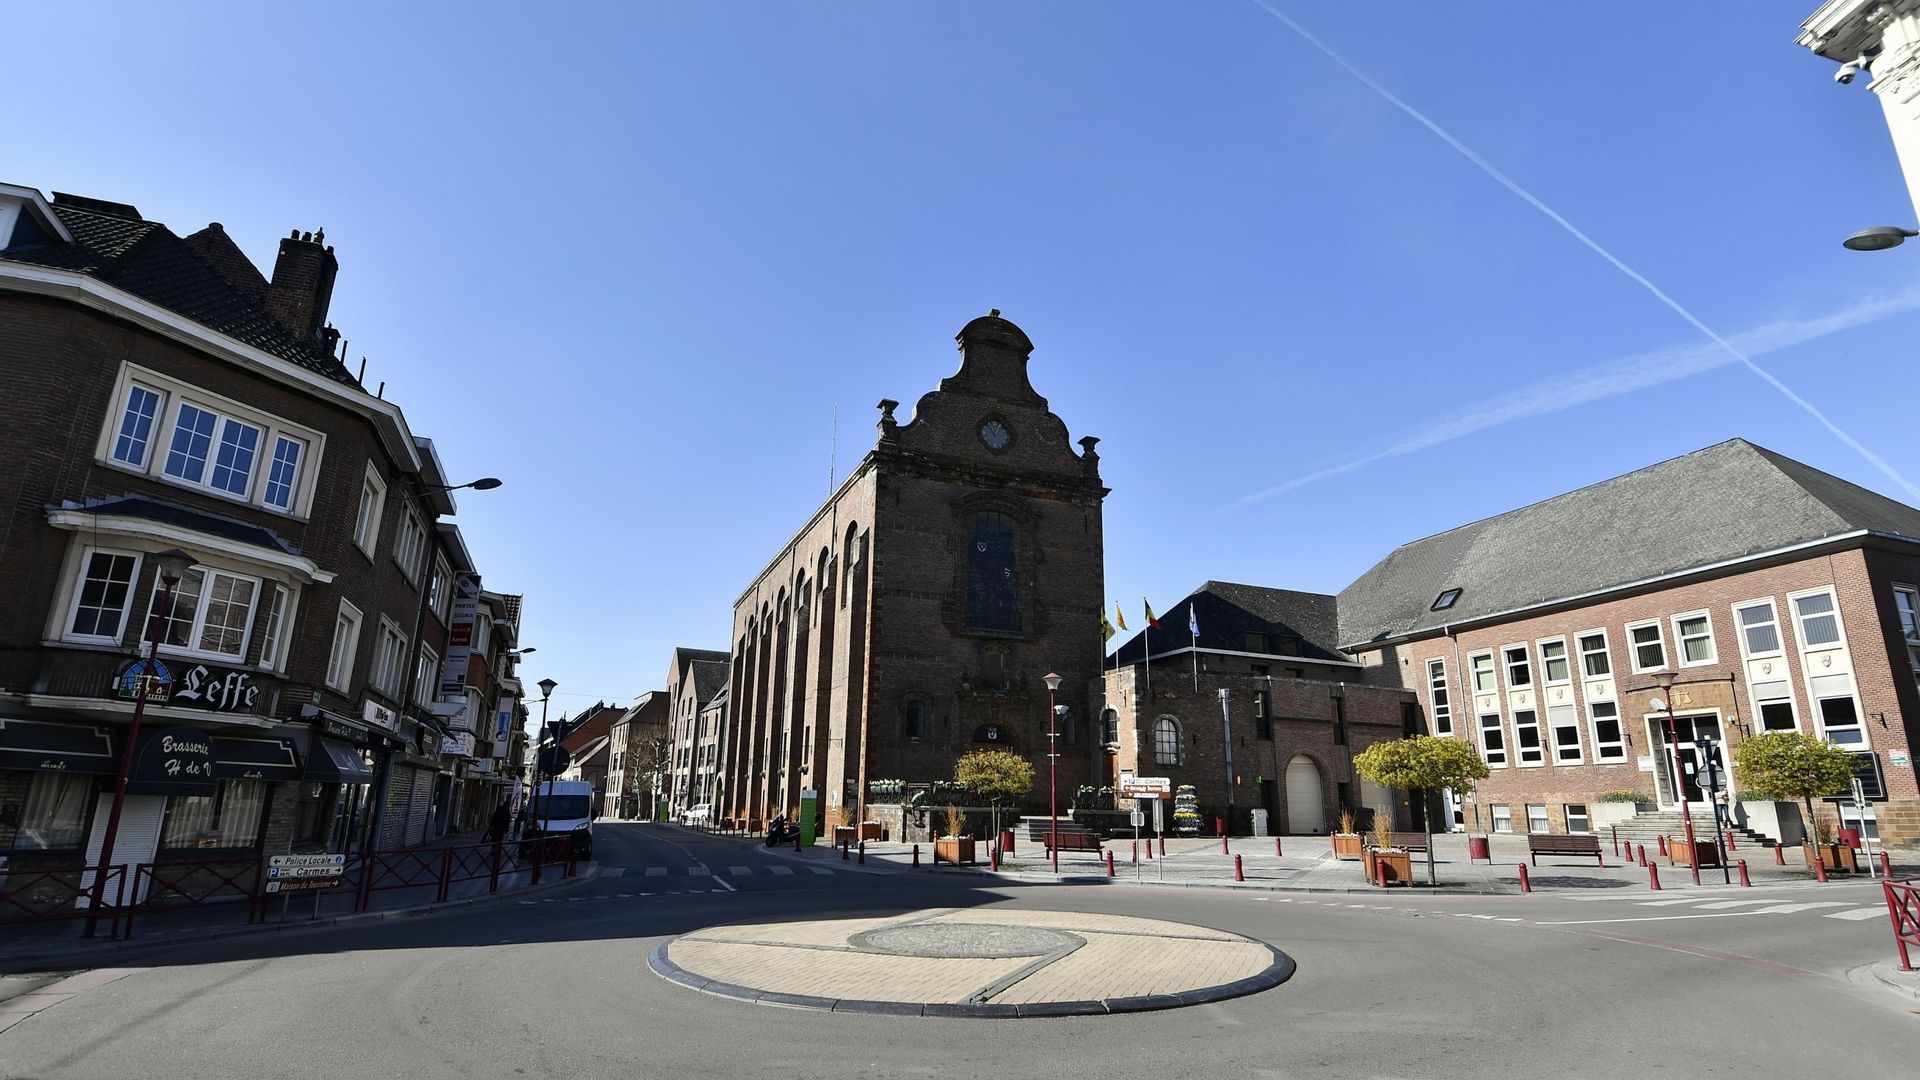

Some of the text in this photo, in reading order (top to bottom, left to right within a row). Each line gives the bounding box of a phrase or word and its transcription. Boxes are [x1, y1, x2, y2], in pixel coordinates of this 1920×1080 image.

[175, 664, 260, 710] Leffe
[162, 735, 209, 755] Brasserie
[164, 758, 212, 777] H de V
[285, 856, 332, 865] Police Locale
[296, 867, 330, 876] Carmes
